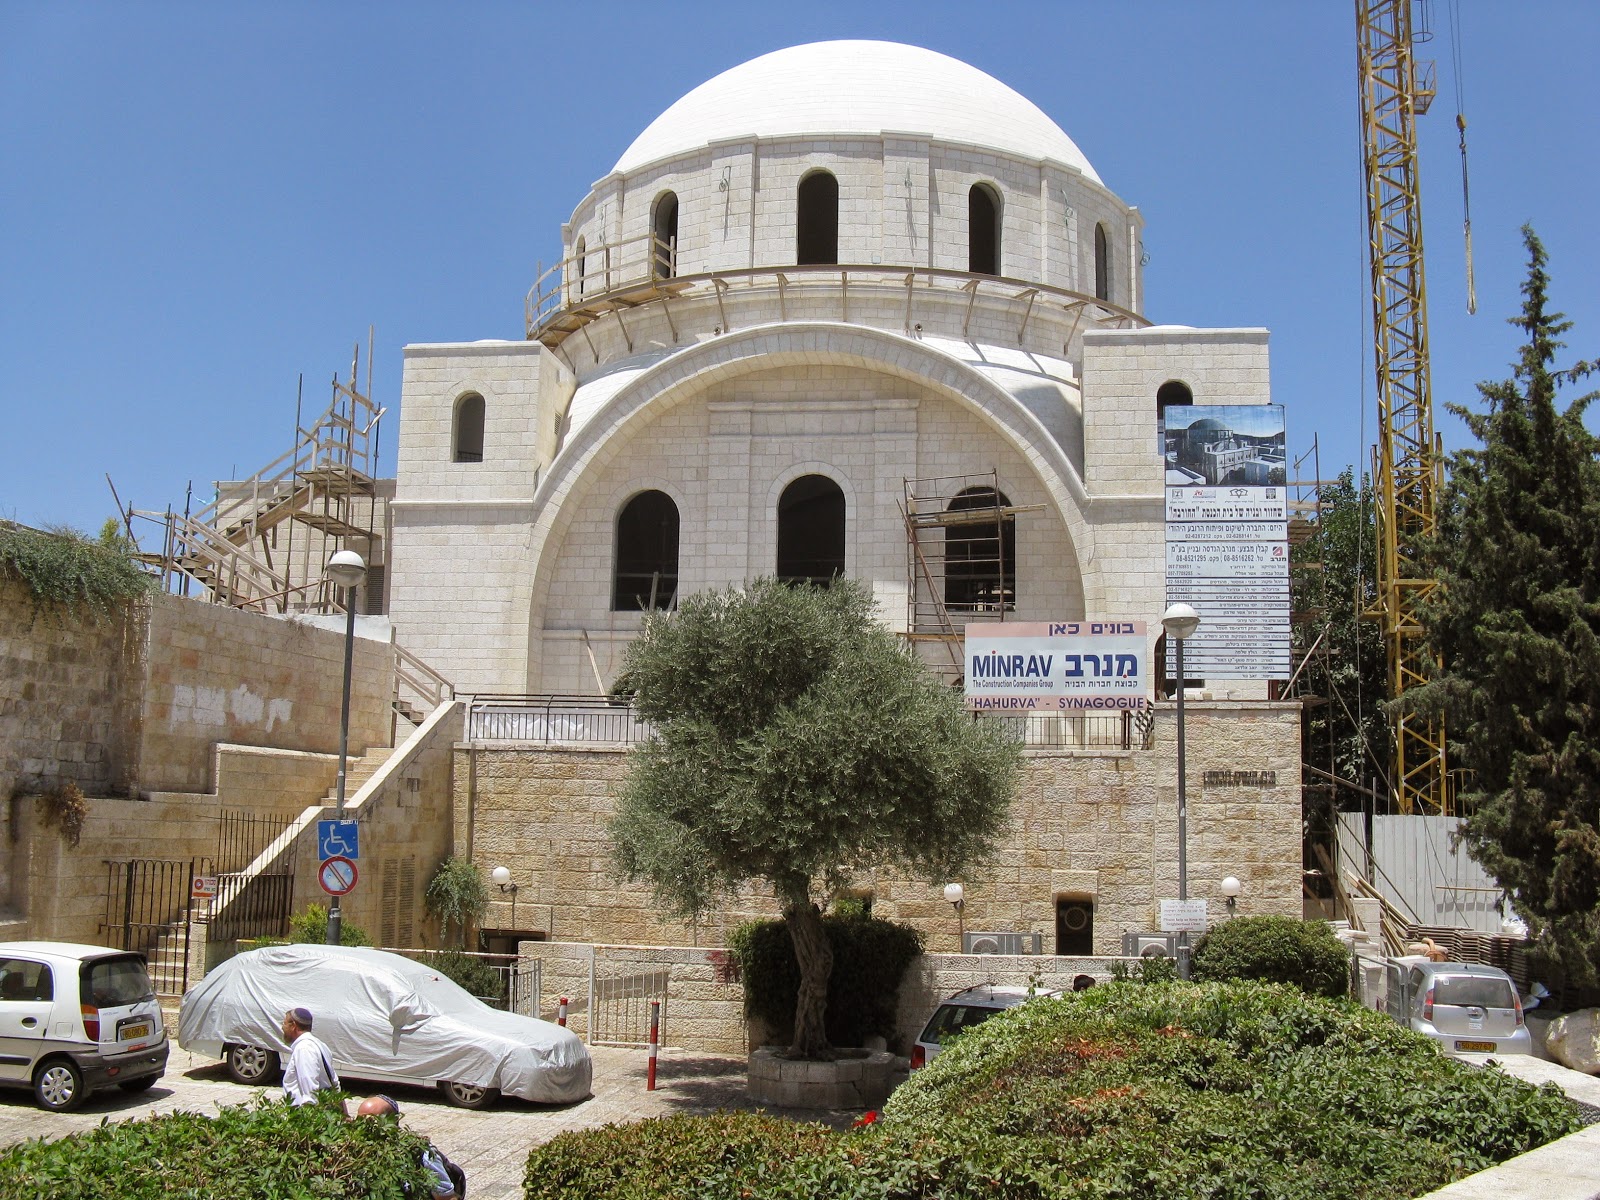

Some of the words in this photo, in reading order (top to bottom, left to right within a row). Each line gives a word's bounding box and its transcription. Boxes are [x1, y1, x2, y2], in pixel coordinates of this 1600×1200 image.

[1202, 507, 1220, 518] הכנסת
[1222, 507, 1233, 518] בית
[1235, 504, 1244, 518] של
[1246, 507, 1262, 518] ובניה
[1226, 524, 1244, 533] לשיקום
[1256, 544, 1268, 554] קבלן
[1049, 624, 1080, 636] כאן
[1091, 623, 1134, 634] בונים
[1065, 654, 1138, 678] מנרב
[1013, 680, 1038, 689] Companies
[1039, 680, 1053, 689] Group
[968, 698, 1040, 708] "HAHURVA"
[1059, 698, 1144, 708] SYNAGOGUE
